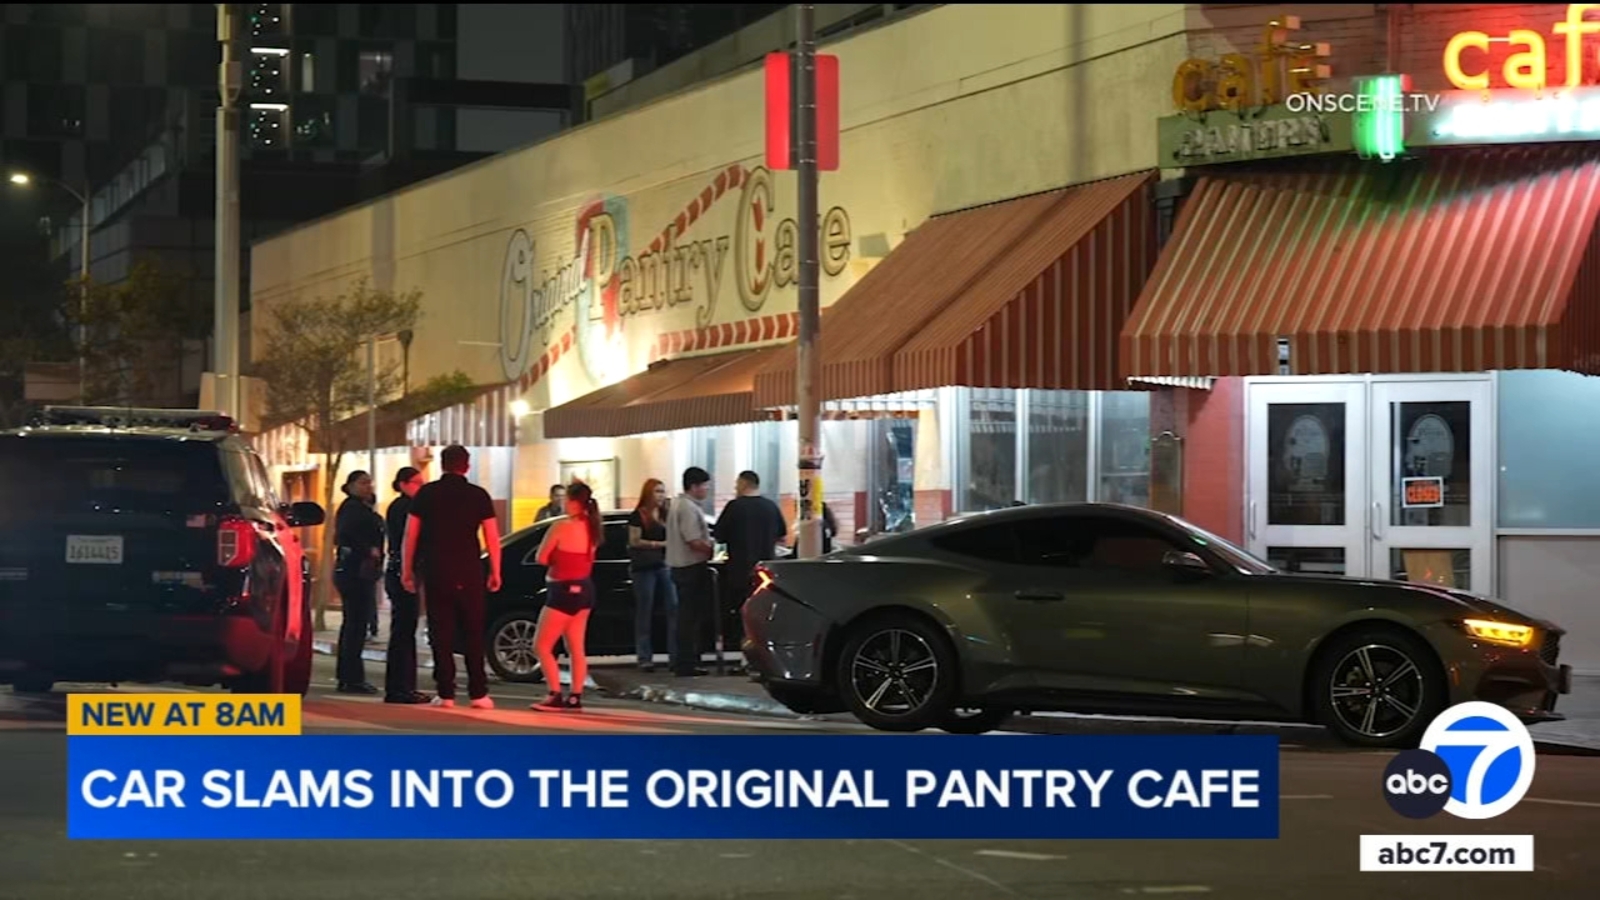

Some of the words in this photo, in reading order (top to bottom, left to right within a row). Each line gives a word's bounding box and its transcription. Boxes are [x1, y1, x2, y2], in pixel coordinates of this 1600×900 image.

[1443, 4, 1600, 94] caf
[588, 211, 730, 330] Pantry
[735, 165, 851, 312] Cae
